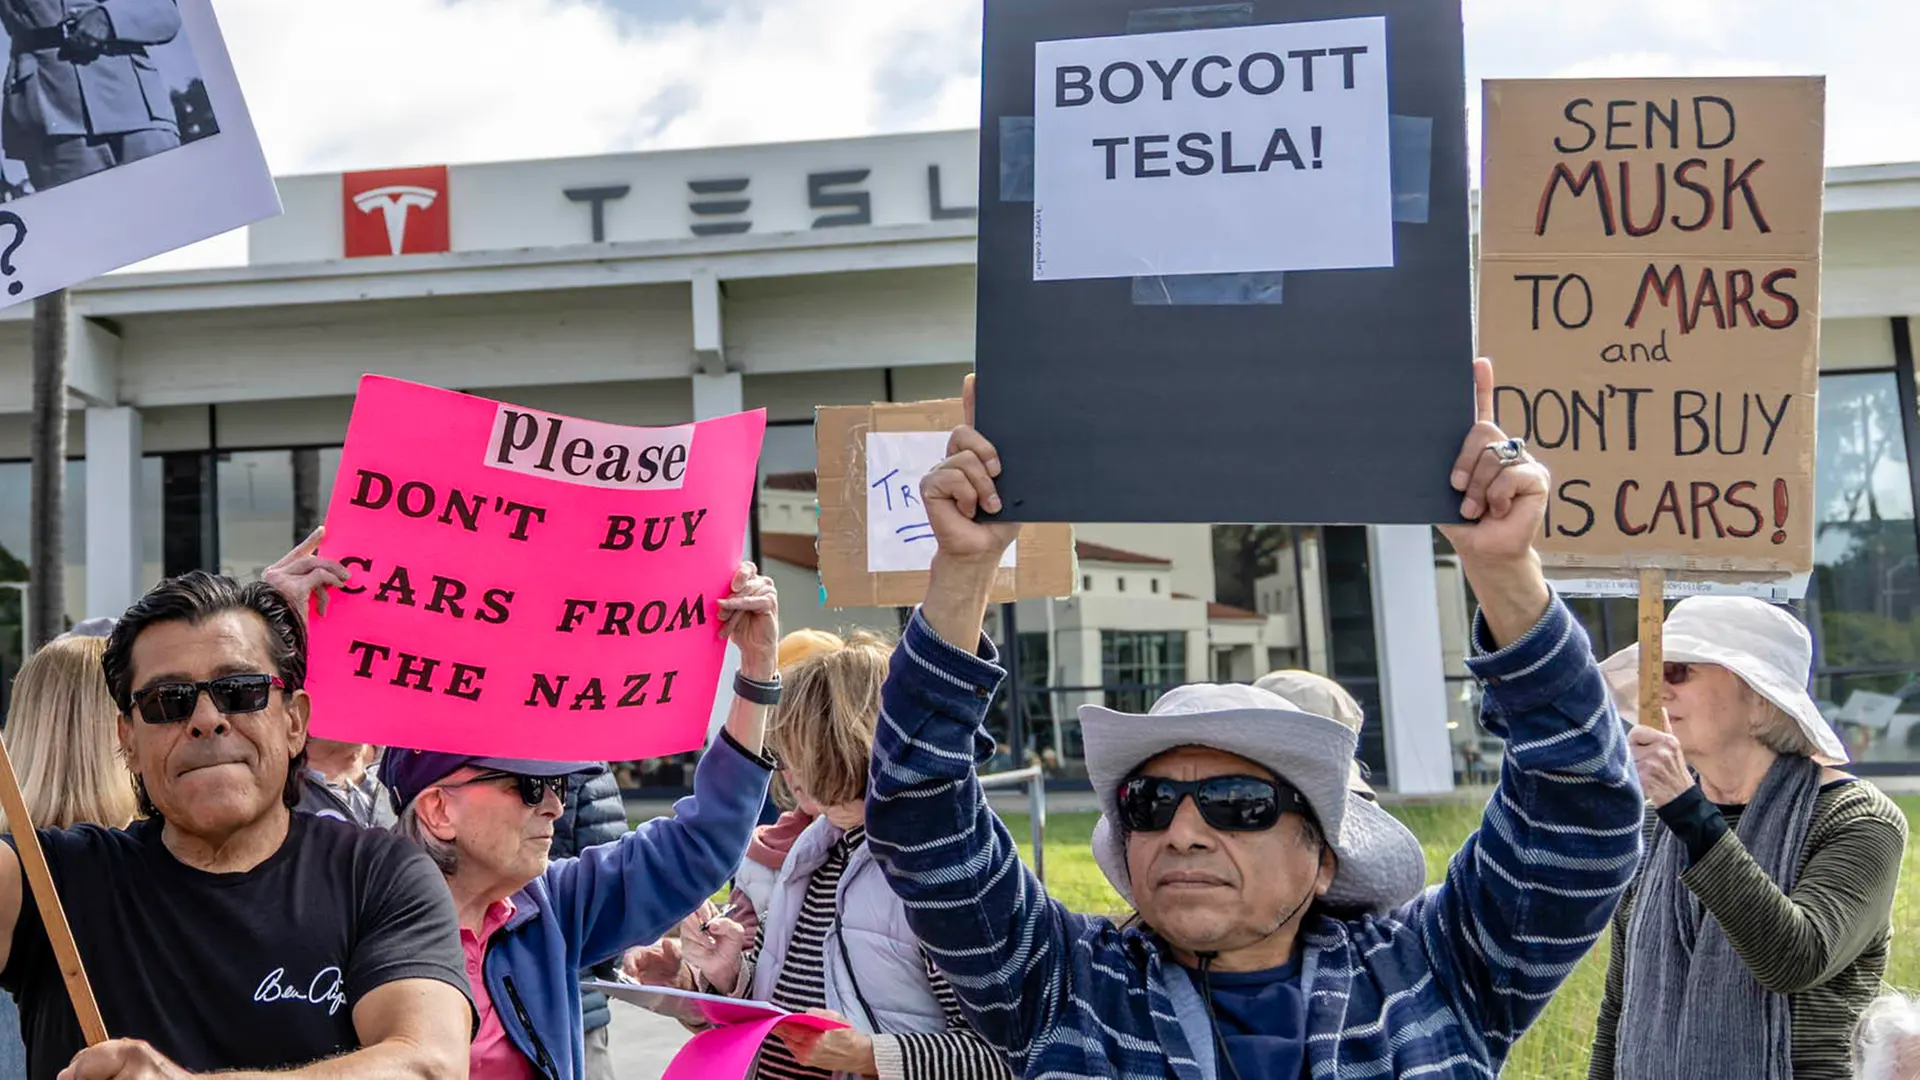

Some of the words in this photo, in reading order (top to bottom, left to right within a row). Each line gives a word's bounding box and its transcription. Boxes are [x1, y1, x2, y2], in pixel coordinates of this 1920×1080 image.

[1055, 46, 1368, 107] BOYCOTT
[1092, 126, 1323, 180] TESLA!
[1553, 96, 1736, 153] SEND
[562, 164, 978, 243] TESL
[1534, 158, 1772, 236] MUSK
[1514, 273, 1593, 330] TO
[1624, 263, 1799, 334] MARS
[1600, 329, 1672, 363] and
[496, 408, 688, 484] please
[1493, 384, 1654, 452] DON'T
[1674, 390, 1792, 456] BUY
[349, 469, 547, 542] DON'T
[599, 508, 708, 552] BUY
[872, 468, 920, 511] TR
[1543, 479, 1595, 538] IS
[1614, 477, 1789, 545] CARS!
[339, 556, 516, 625] CARS
[555, 593, 707, 638] FROM
[348, 639, 488, 702] THE
[523, 669, 680, 712] NAZI
